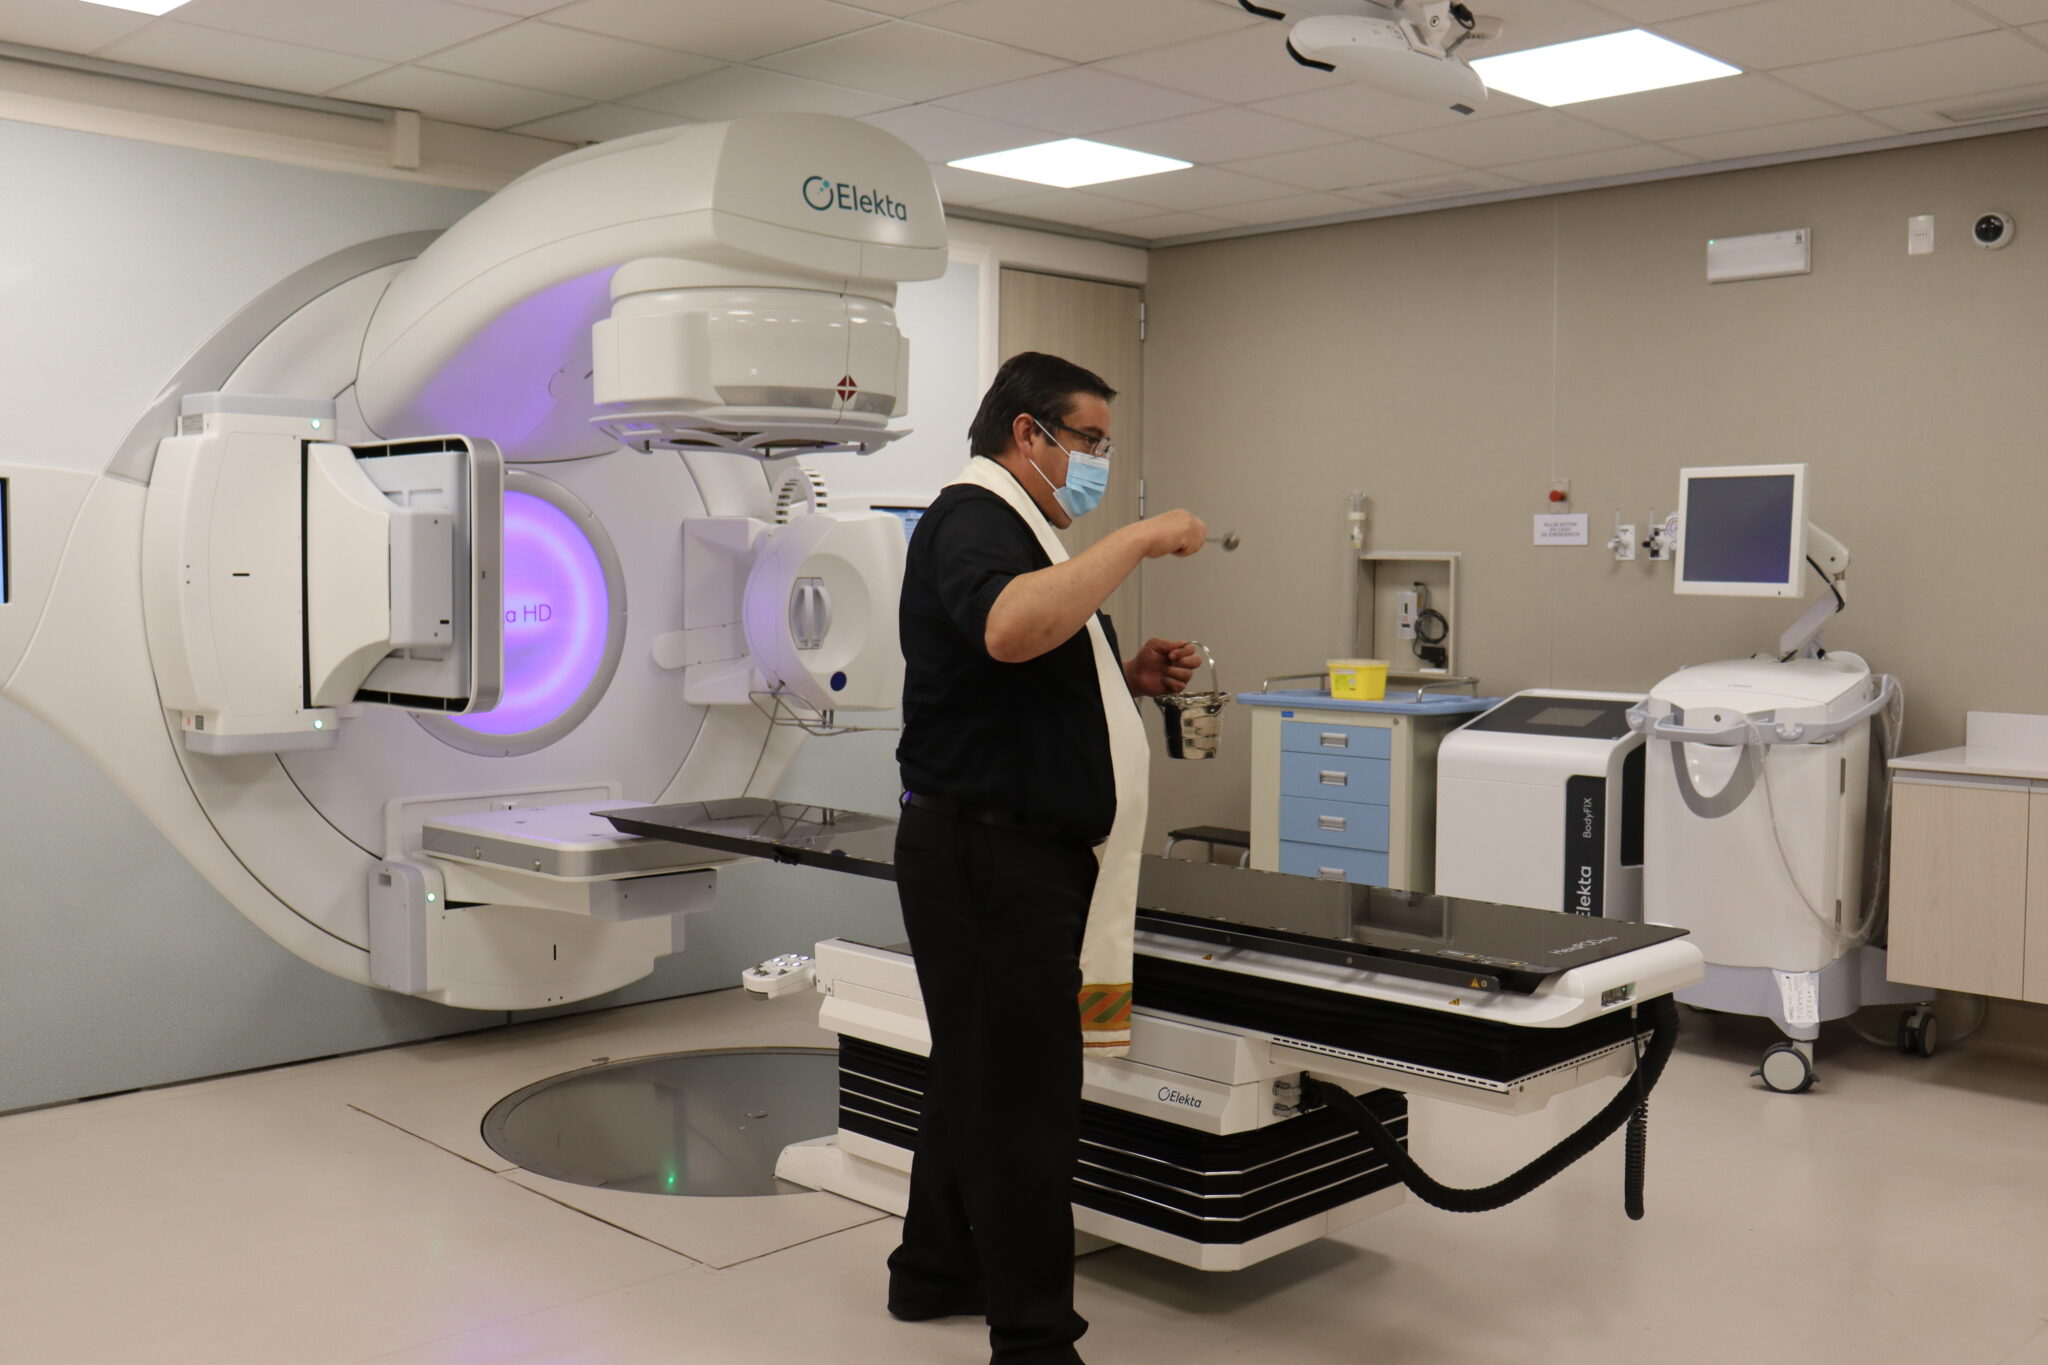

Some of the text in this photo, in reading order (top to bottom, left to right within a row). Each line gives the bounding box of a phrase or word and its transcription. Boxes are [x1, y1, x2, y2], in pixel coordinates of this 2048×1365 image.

[836, 182, 907, 222] Elekta
[523, 604, 552, 622] HD
[1582, 797, 1593, 838] BodyFIX
[1169, 1090, 1202, 1108] Elekta
